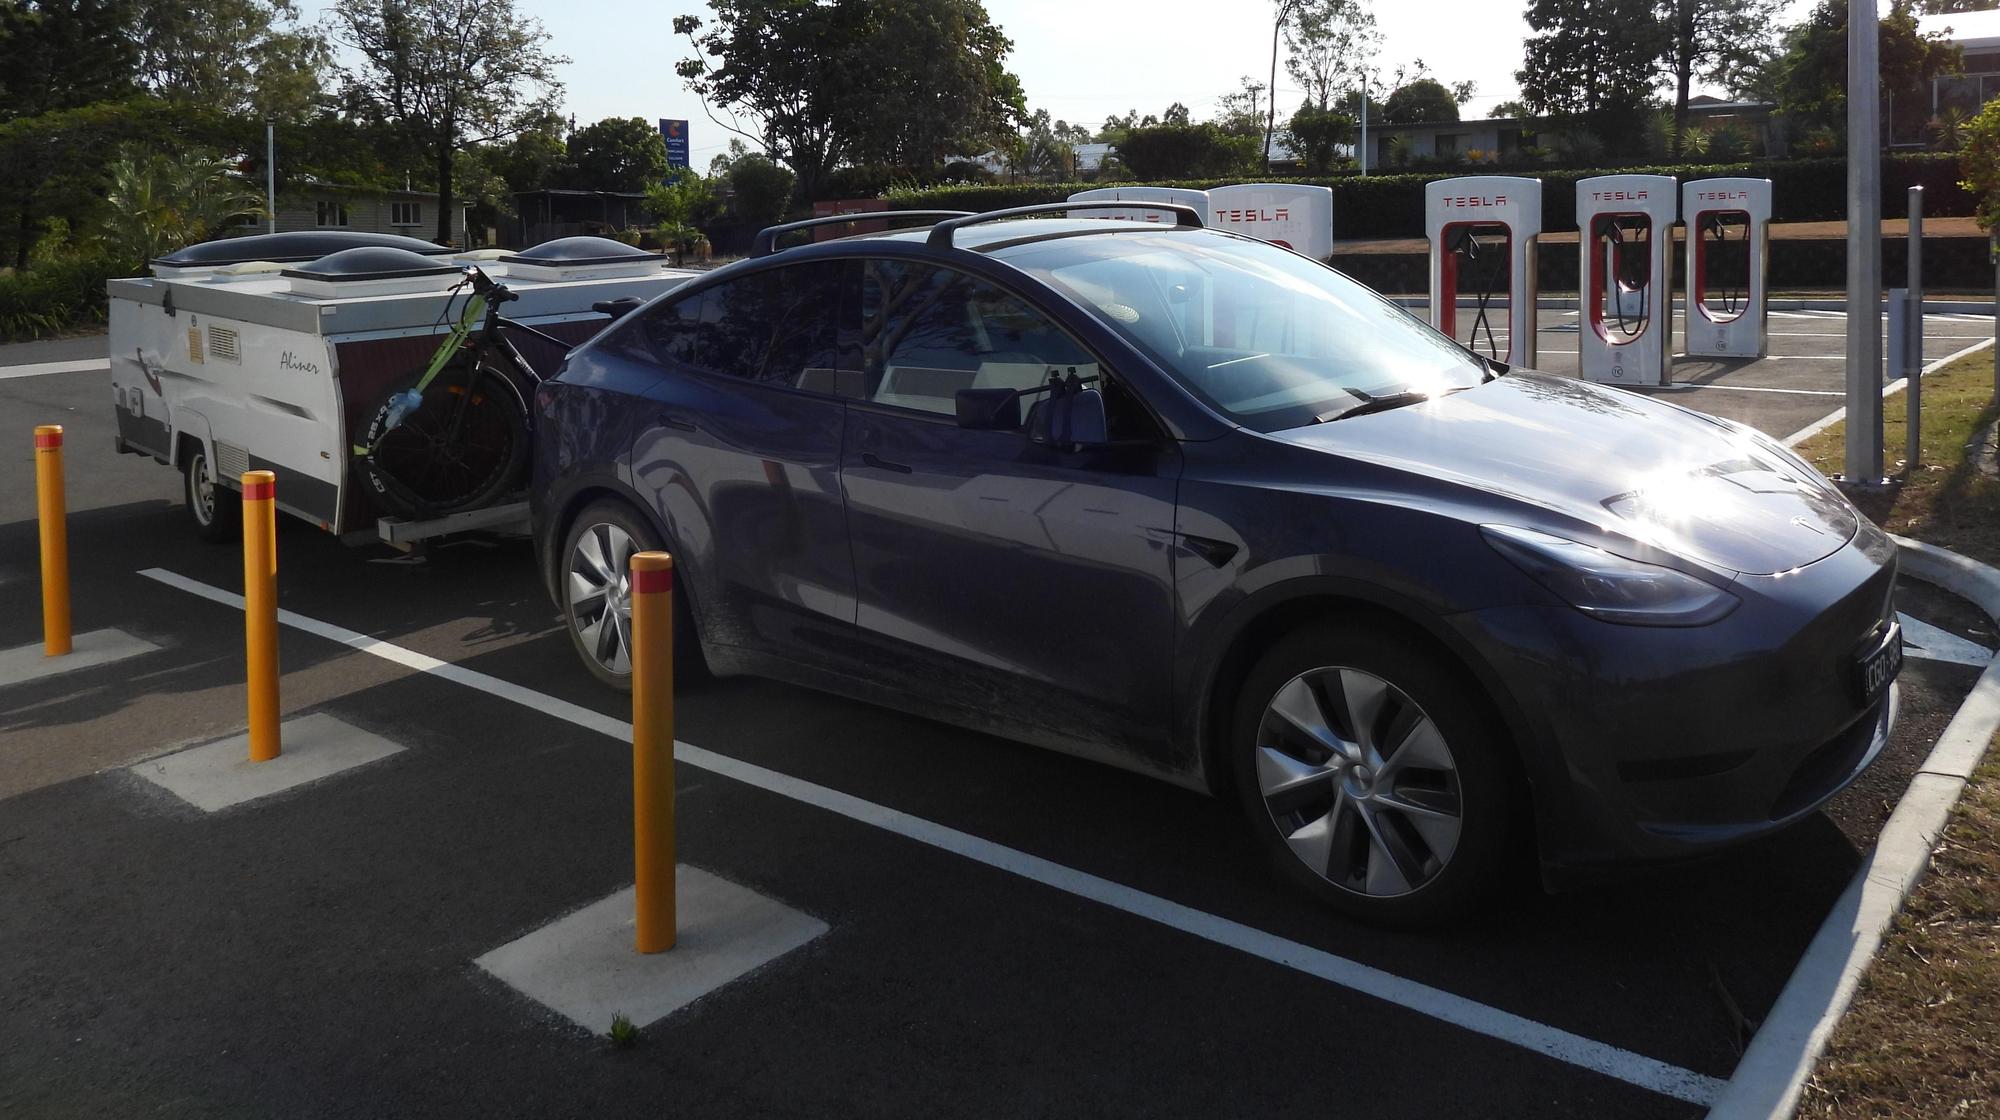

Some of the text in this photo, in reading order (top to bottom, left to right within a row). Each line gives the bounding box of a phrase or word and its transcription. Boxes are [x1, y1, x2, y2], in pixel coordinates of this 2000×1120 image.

[1443, 196, 1507, 207] TESLA
[1592, 191, 1648, 201] TESLA
[1698, 192, 1748, 200] TESLA
[1216, 209, 1288, 223] TESLA
[280, 351, 320, 375] Aliner
[369, 471, 386, 493] CST
